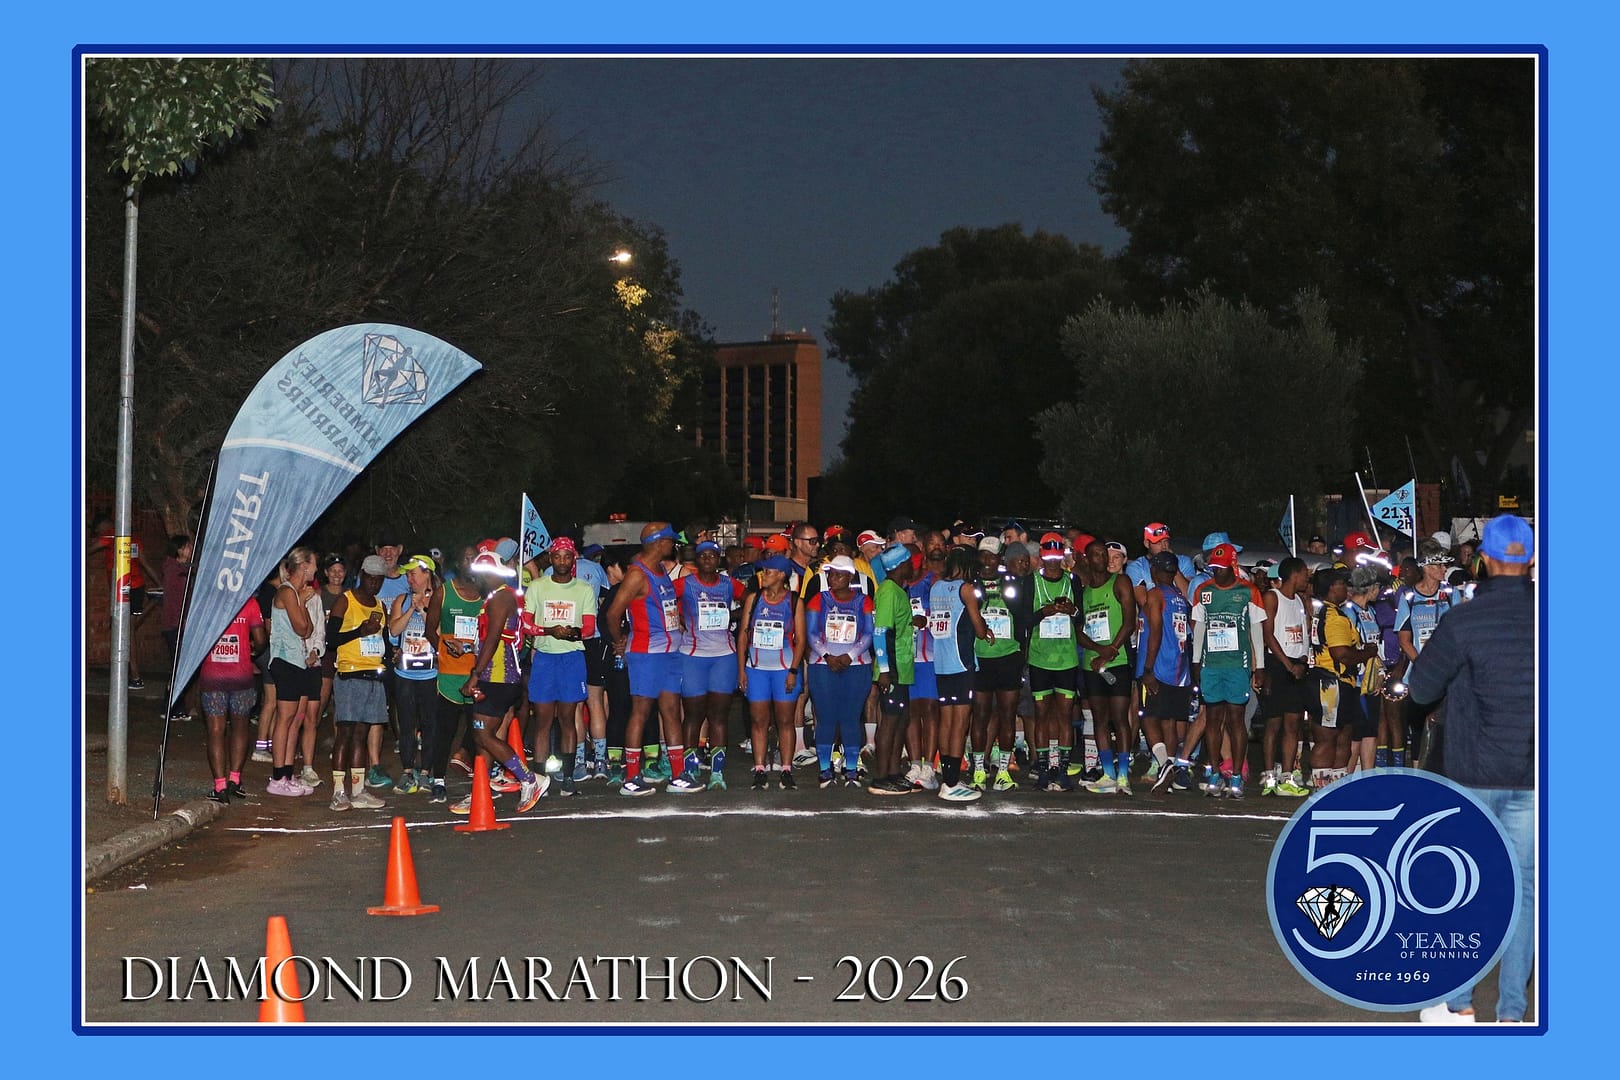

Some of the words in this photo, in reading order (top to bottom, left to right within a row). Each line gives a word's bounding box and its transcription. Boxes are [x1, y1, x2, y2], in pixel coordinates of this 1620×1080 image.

[1381, 506, 1411, 519] 21.1
[1202, 593, 1212, 603] 50
[936, 621, 948, 631] 191
[216, 645, 238, 655] 20964
